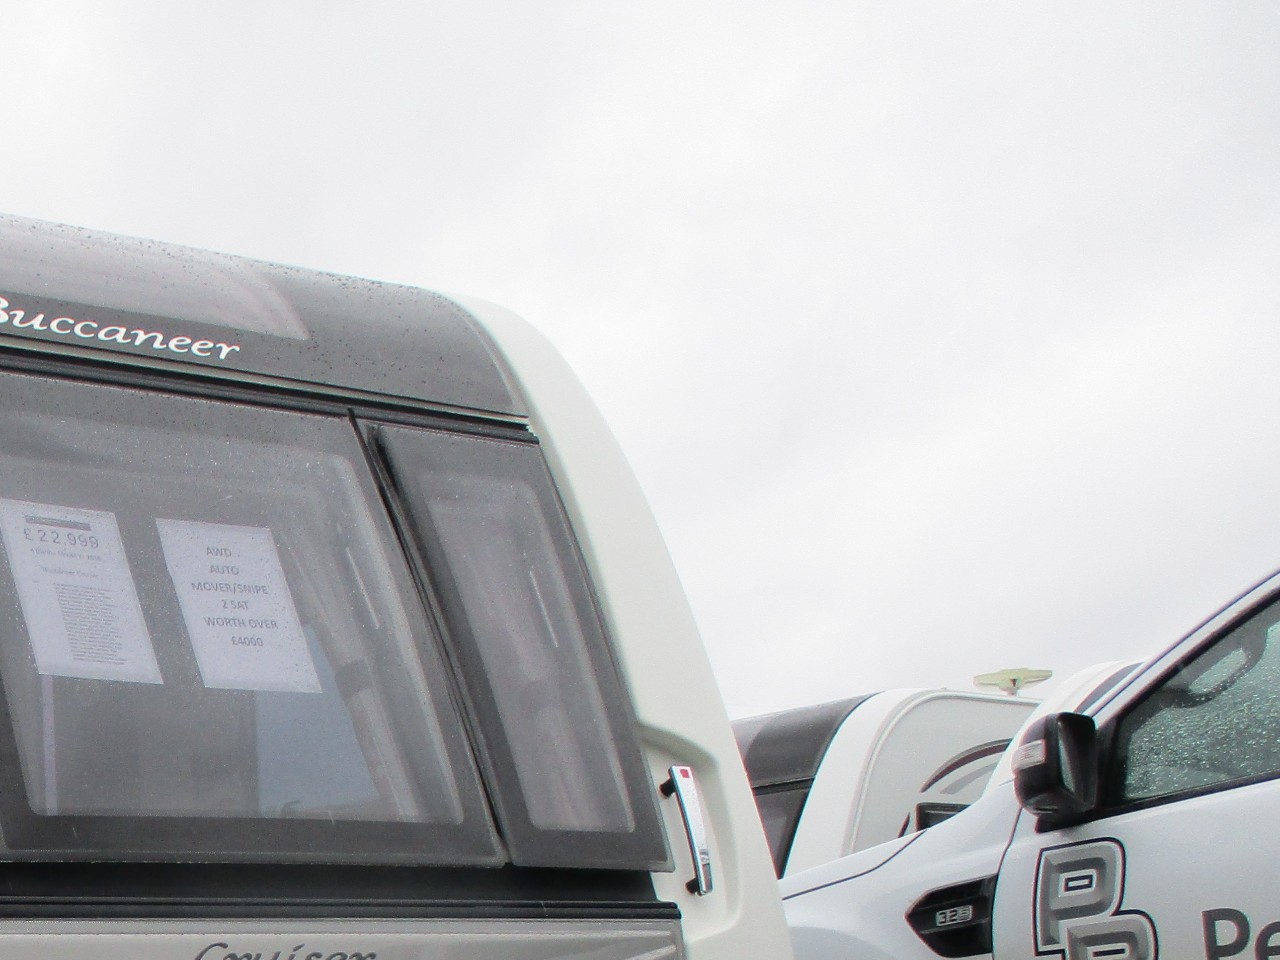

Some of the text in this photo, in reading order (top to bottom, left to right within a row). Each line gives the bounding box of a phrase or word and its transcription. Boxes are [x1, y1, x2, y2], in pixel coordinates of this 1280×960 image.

[206, 546, 232, 558] AWD
[210, 564, 240, 575] AUTO
[221, 599, 249, 610] 2 SAT
[203, 616, 279, 630] WORTH OVER
[231, 635, 264, 647] £4000
